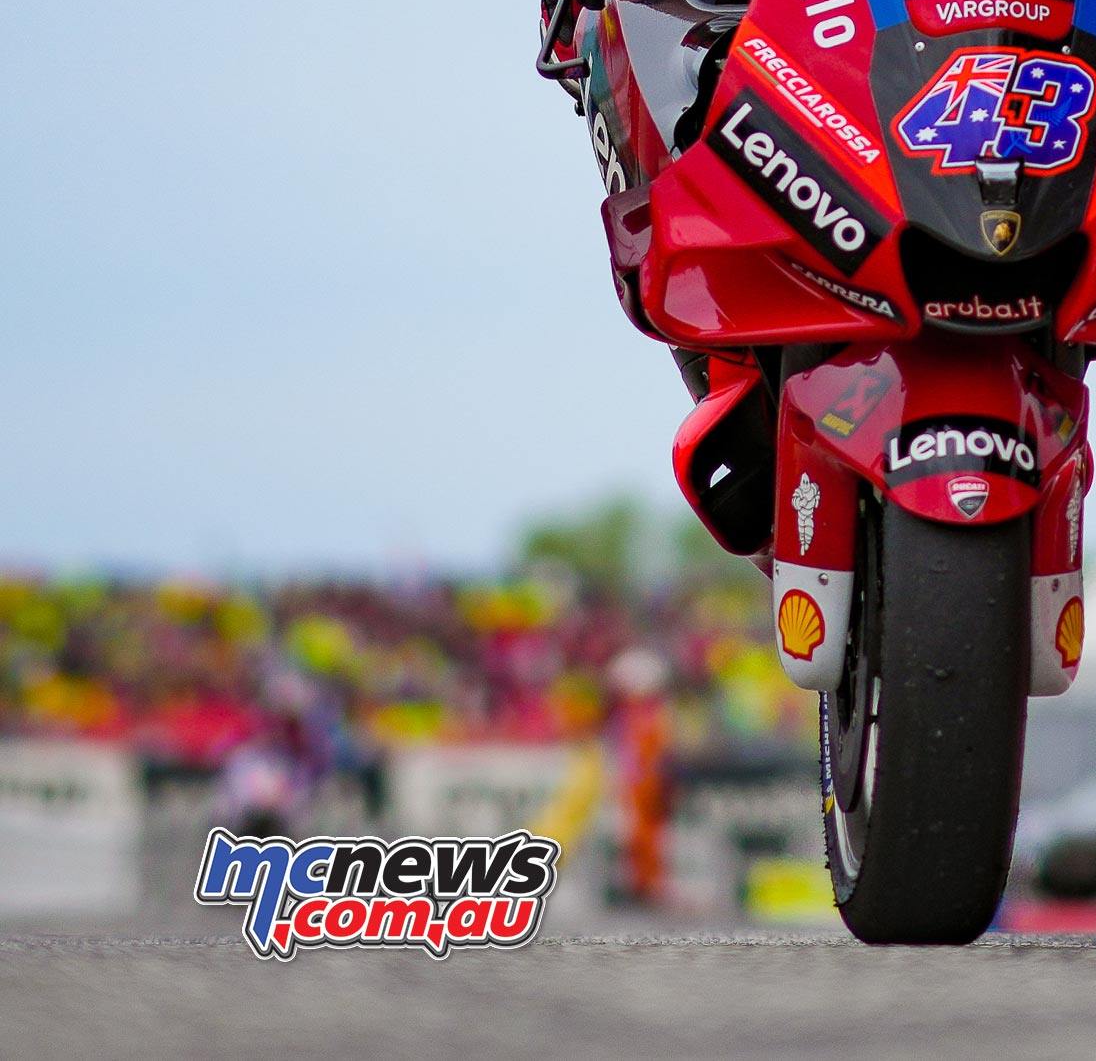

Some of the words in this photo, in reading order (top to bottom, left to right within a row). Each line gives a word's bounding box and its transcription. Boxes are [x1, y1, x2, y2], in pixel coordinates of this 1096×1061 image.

[935, 0, 1051, 24] VARGROUP
[743, 37, 881, 164] FRECCIAROSSA
[720, 102, 866, 252] Lenovo
[791, 261, 895, 318] CARRERA
[924, 294, 1043, 319] aruba.it
[889, 428, 1035, 471] Lenovo
[952, 481, 987, 492] DUCATI
